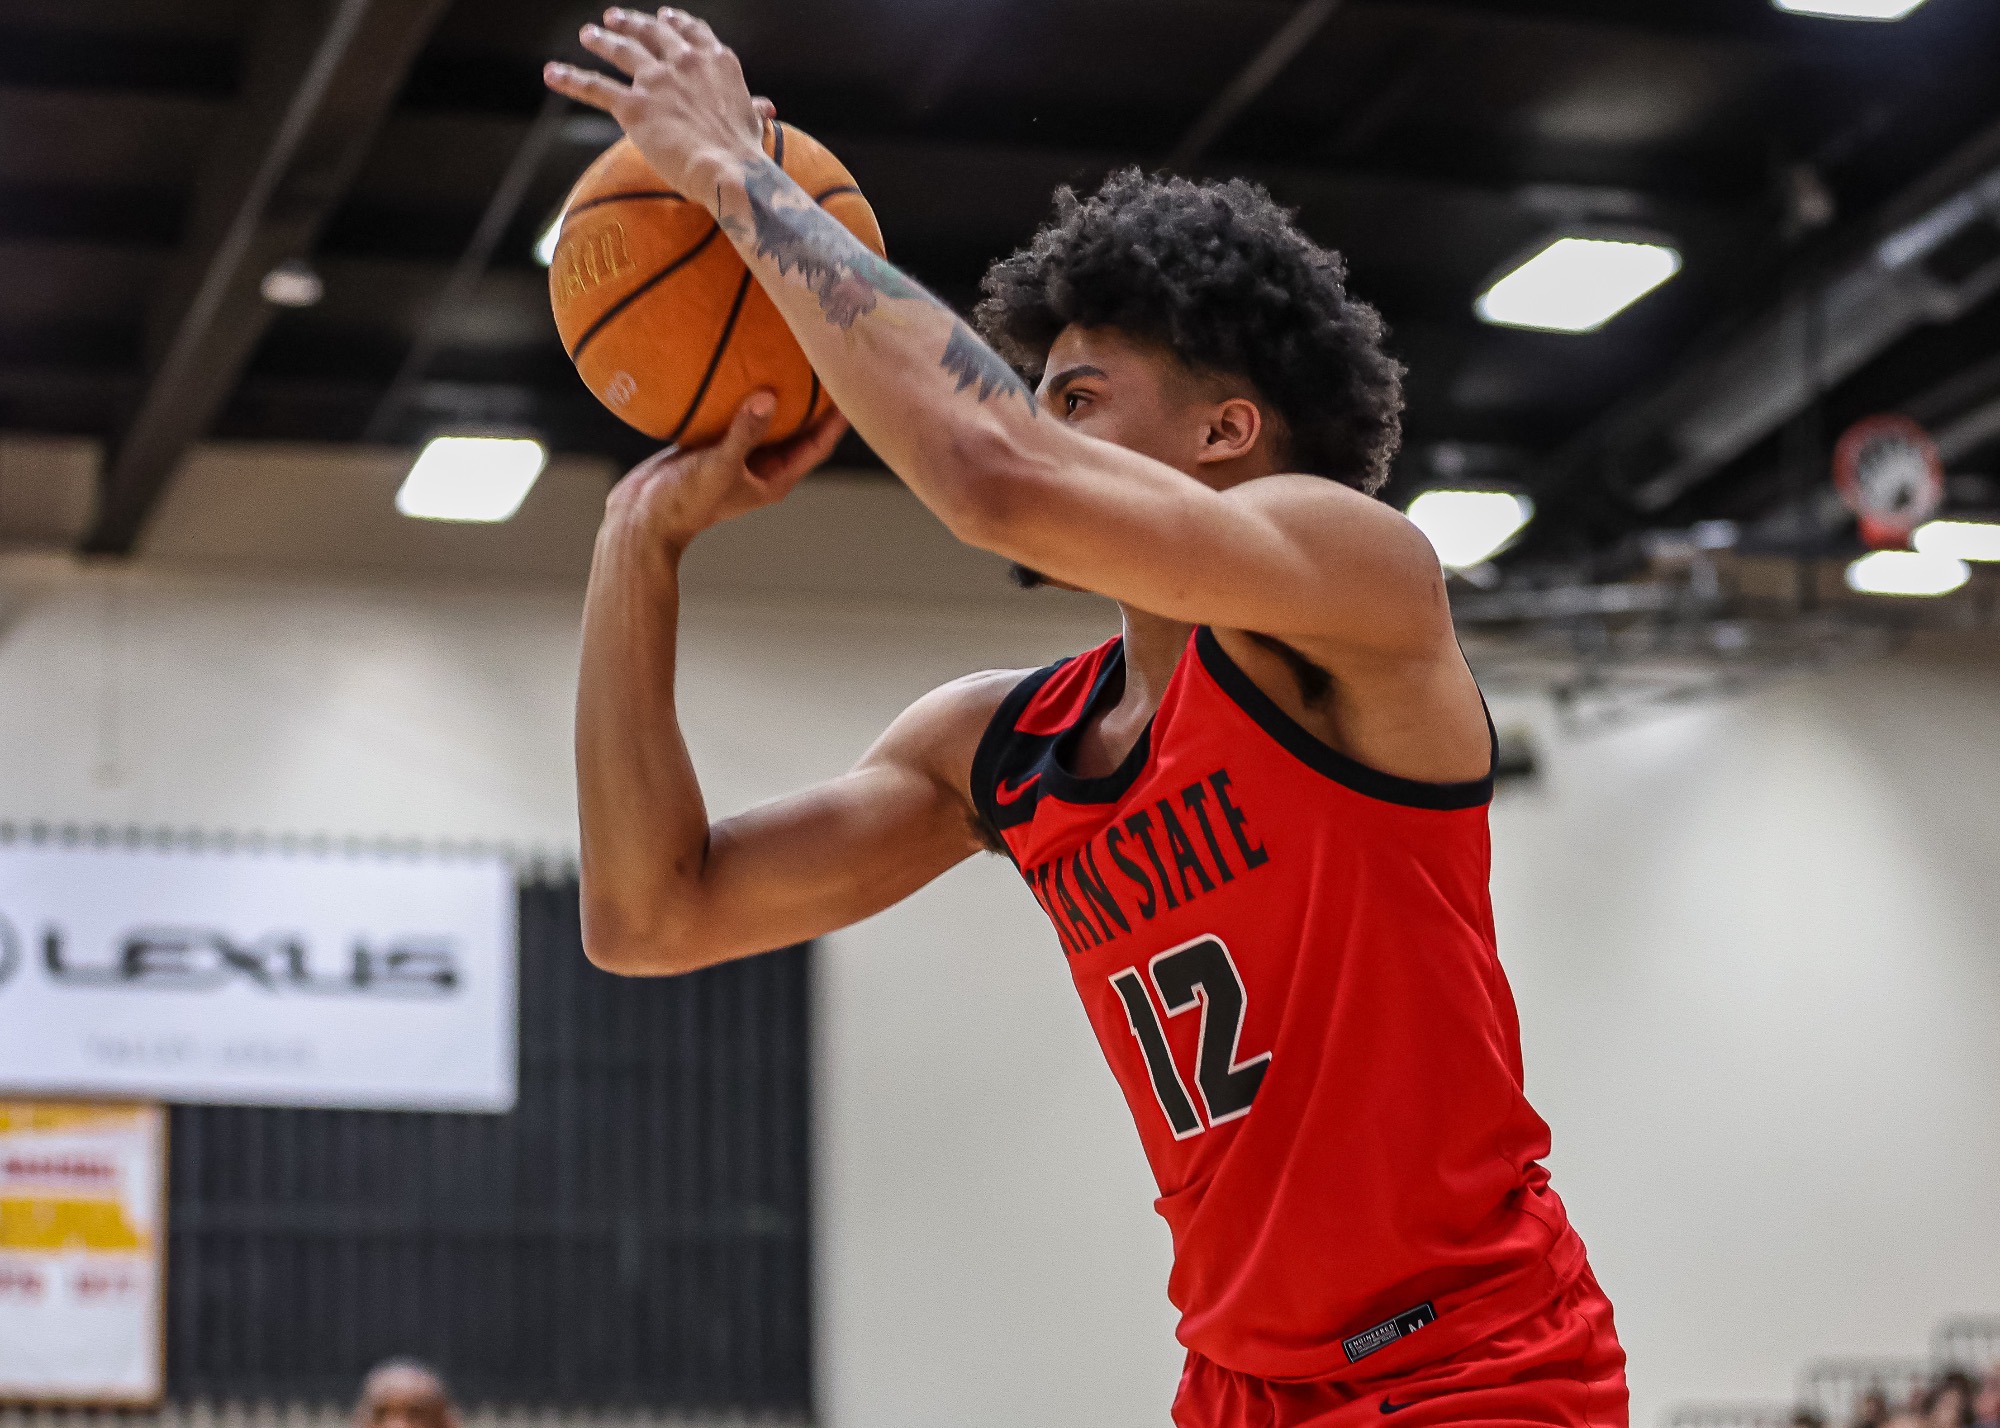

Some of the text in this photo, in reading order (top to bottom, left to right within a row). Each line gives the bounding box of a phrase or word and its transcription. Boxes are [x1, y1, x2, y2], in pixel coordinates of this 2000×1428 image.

[1106, 768, 1271, 920] STATE
[41, 925, 461, 999] LEXUS
[1108, 932, 1272, 1141] 12
